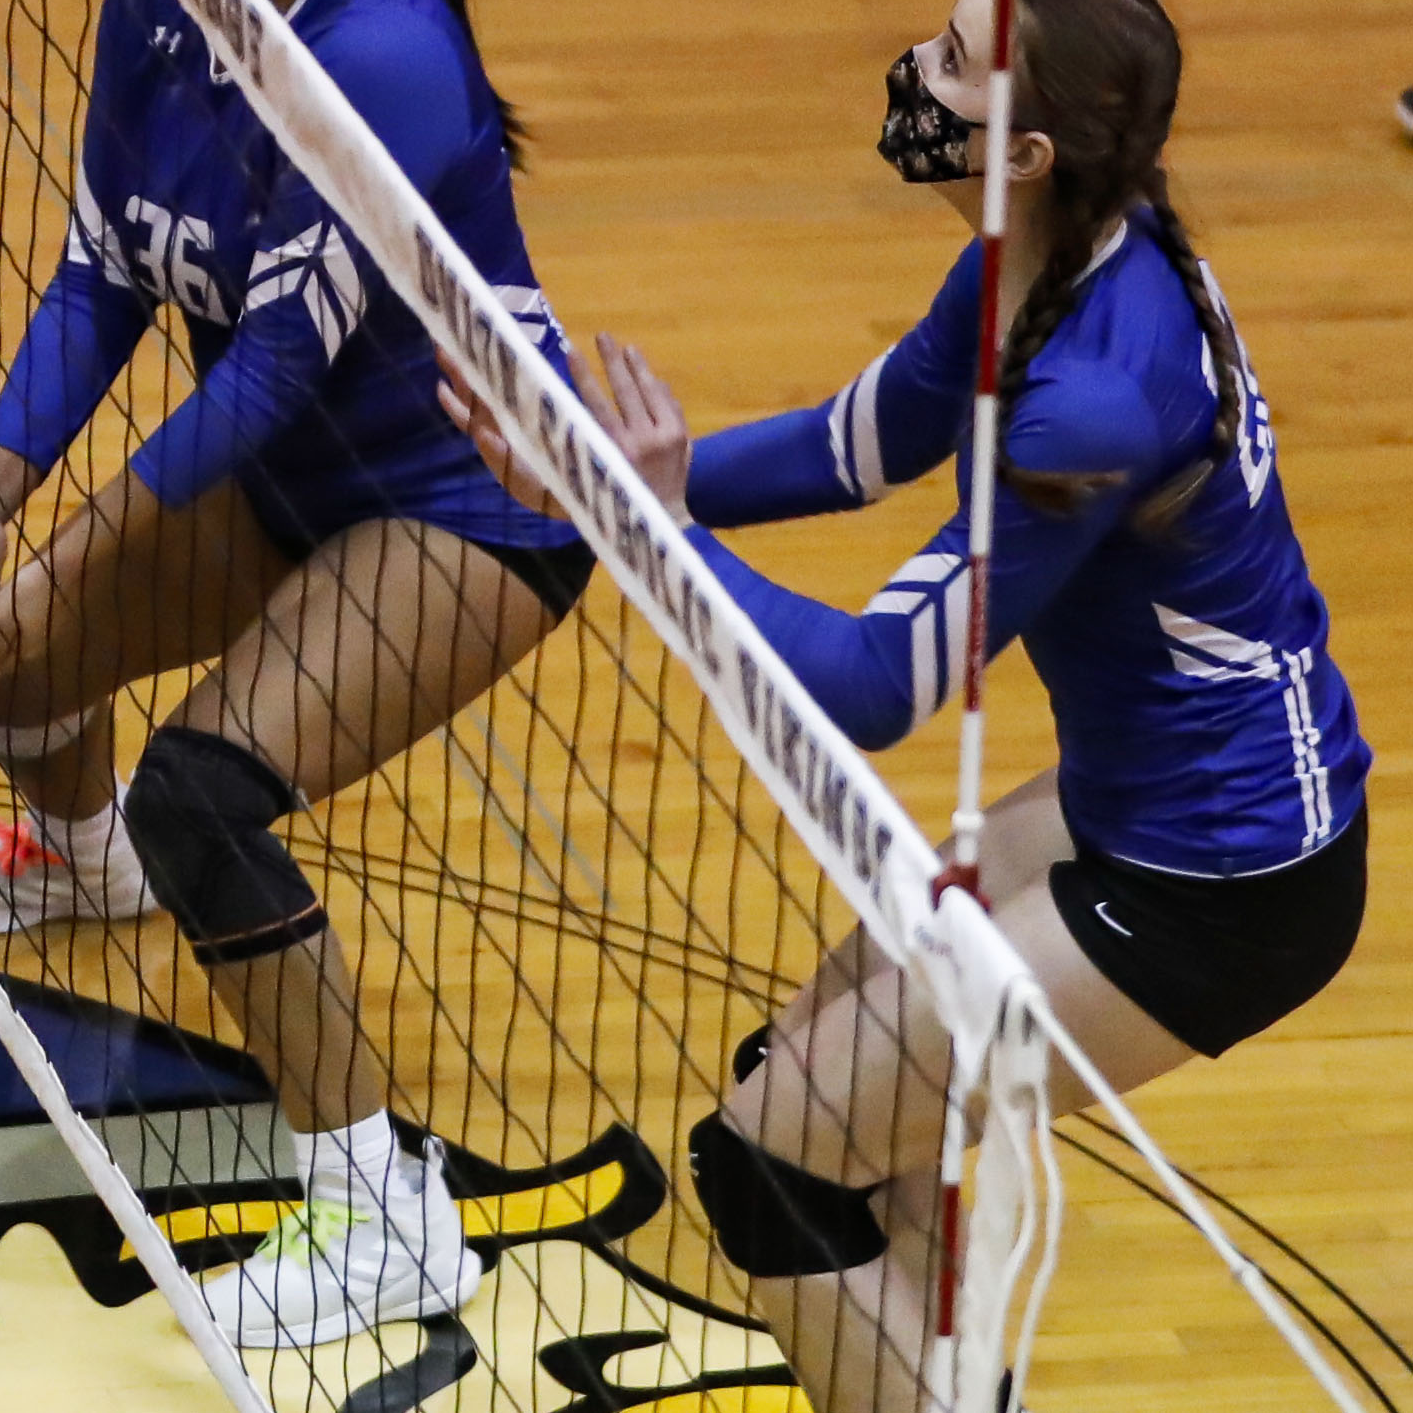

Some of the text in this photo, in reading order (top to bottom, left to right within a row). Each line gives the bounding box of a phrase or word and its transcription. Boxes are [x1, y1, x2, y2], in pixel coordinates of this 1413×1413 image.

[124, 193, 232, 327] 36
[414, 222, 524, 429] UNION
[537, 389, 720, 681] CATHOLIC
